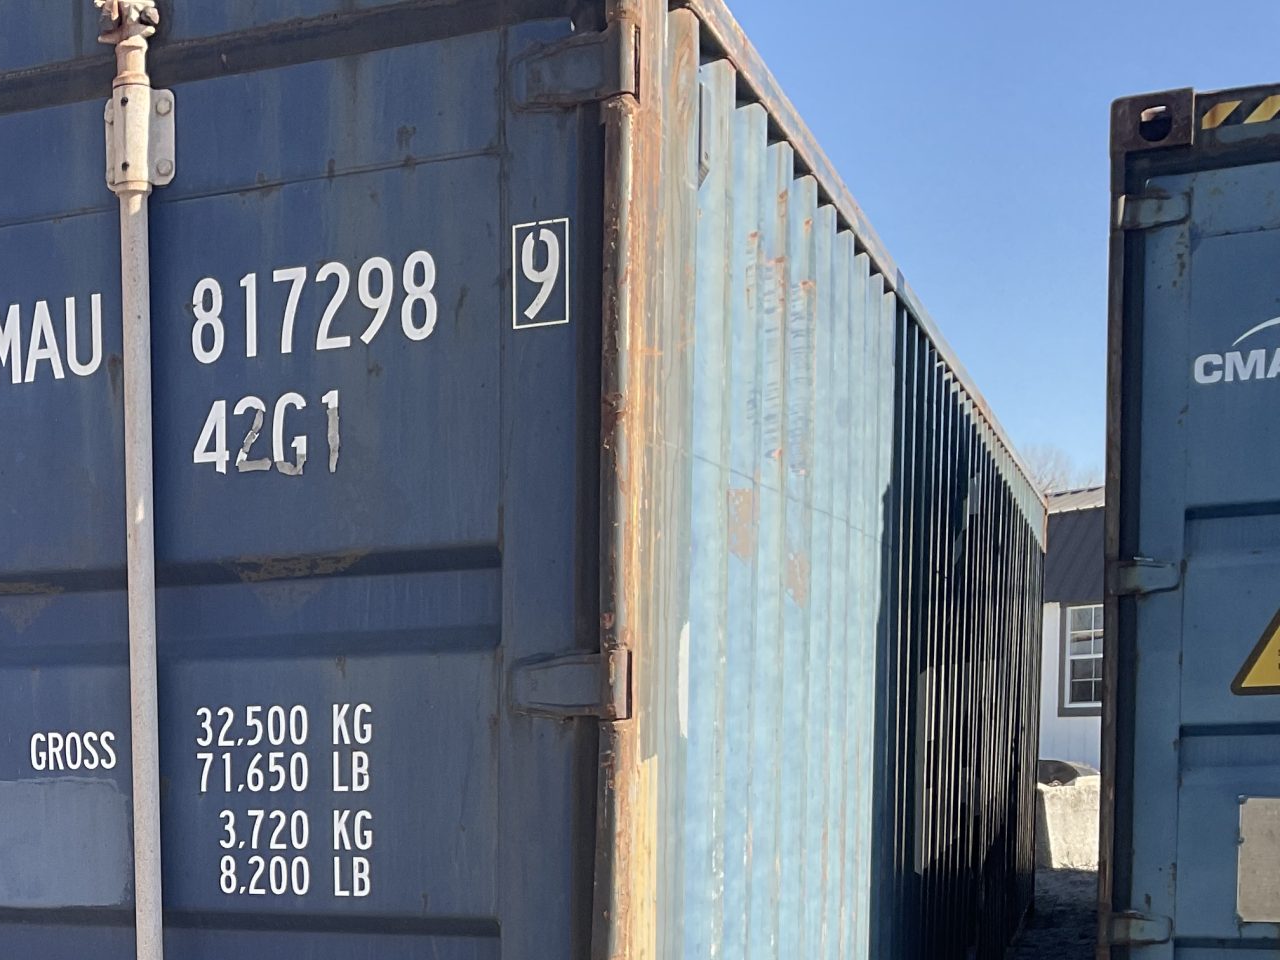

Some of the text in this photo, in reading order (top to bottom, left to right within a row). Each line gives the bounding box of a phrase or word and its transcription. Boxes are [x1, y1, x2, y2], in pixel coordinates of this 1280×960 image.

[191, 250, 438, 365] 817298
[520, 228, 560, 320] 9
[193, 389, 341, 477] 42G1
[30, 731, 118, 772] GROSS
[196, 704, 309, 748] 32,500
[332, 703, 374, 746] KG
[196, 750, 371, 793] 71,650 LB
[219, 809, 310, 852] 3,720
[333, 809, 374, 851] KG
[220, 855, 372, 898] 8,200 LB
